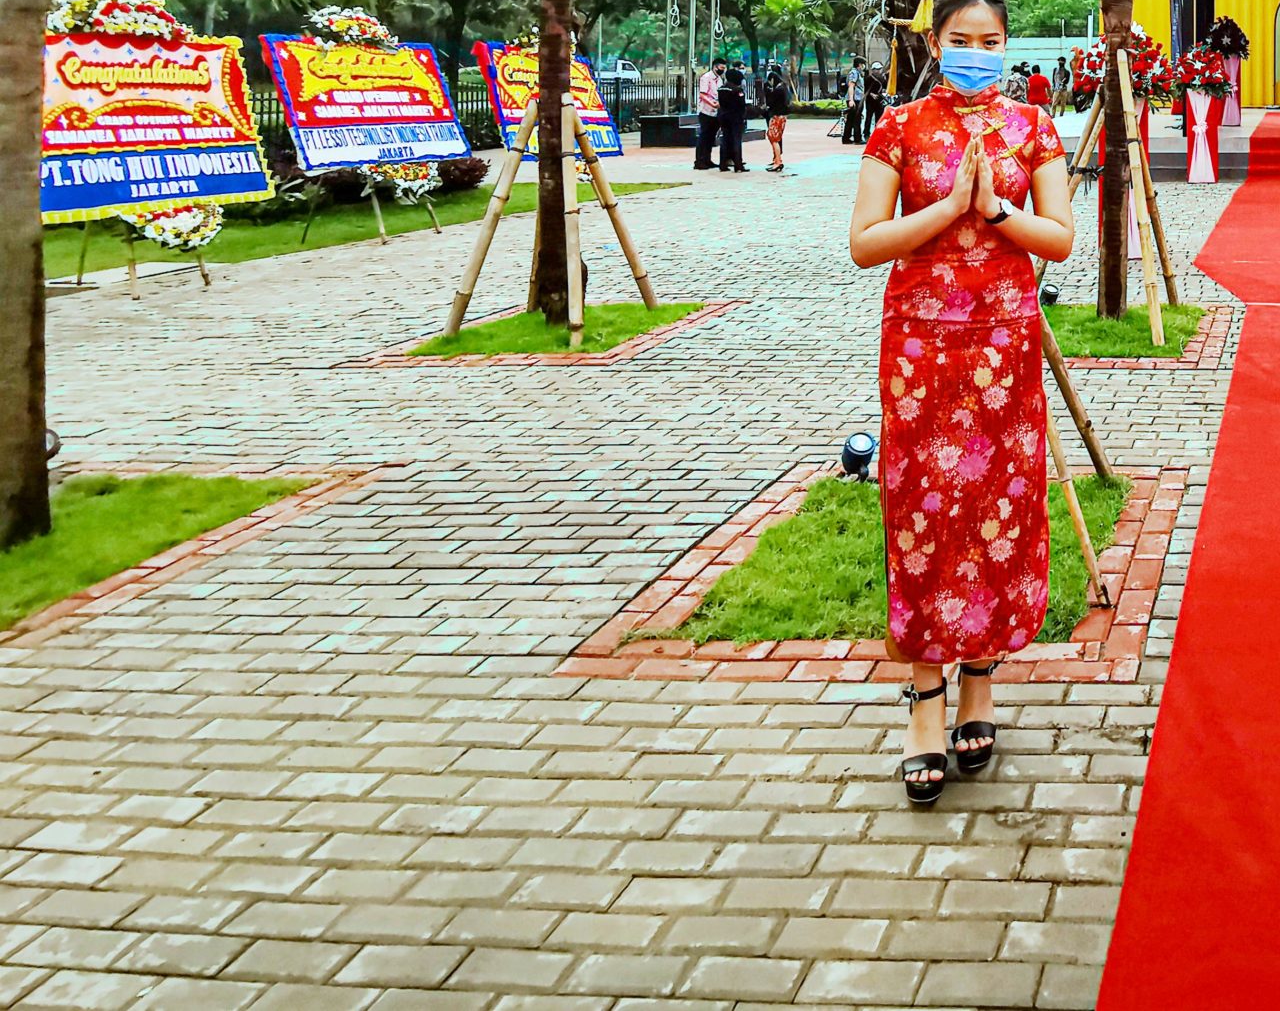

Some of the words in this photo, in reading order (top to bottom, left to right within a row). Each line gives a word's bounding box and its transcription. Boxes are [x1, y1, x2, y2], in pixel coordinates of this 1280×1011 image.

[332, 91, 364, 103] GRAND
[364, 91, 400, 103] OPENING
[362, 105, 400, 118] JAKARTA
[400, 105, 434, 117] MARKET
[96, 115, 134, 126] GRAND
[134, 115, 180, 126] OPENING
[181, 115, 193, 124] OF
[45, 129, 116, 144] SAMANEA
[119, 128, 181, 142] JAKARTA
[183, 126, 236, 139] MARKET
[346, 126, 395, 146] TECHNOLOGY
[394, 125, 431, 144] INDONESIA
[429, 124, 459, 142] TRADING
[378, 146, 415, 160] JAKARTA
[125, 155, 165, 182] HUI
[165, 151, 261, 179] INDONESIA
[130, 179, 199, 198] JAKARTA
